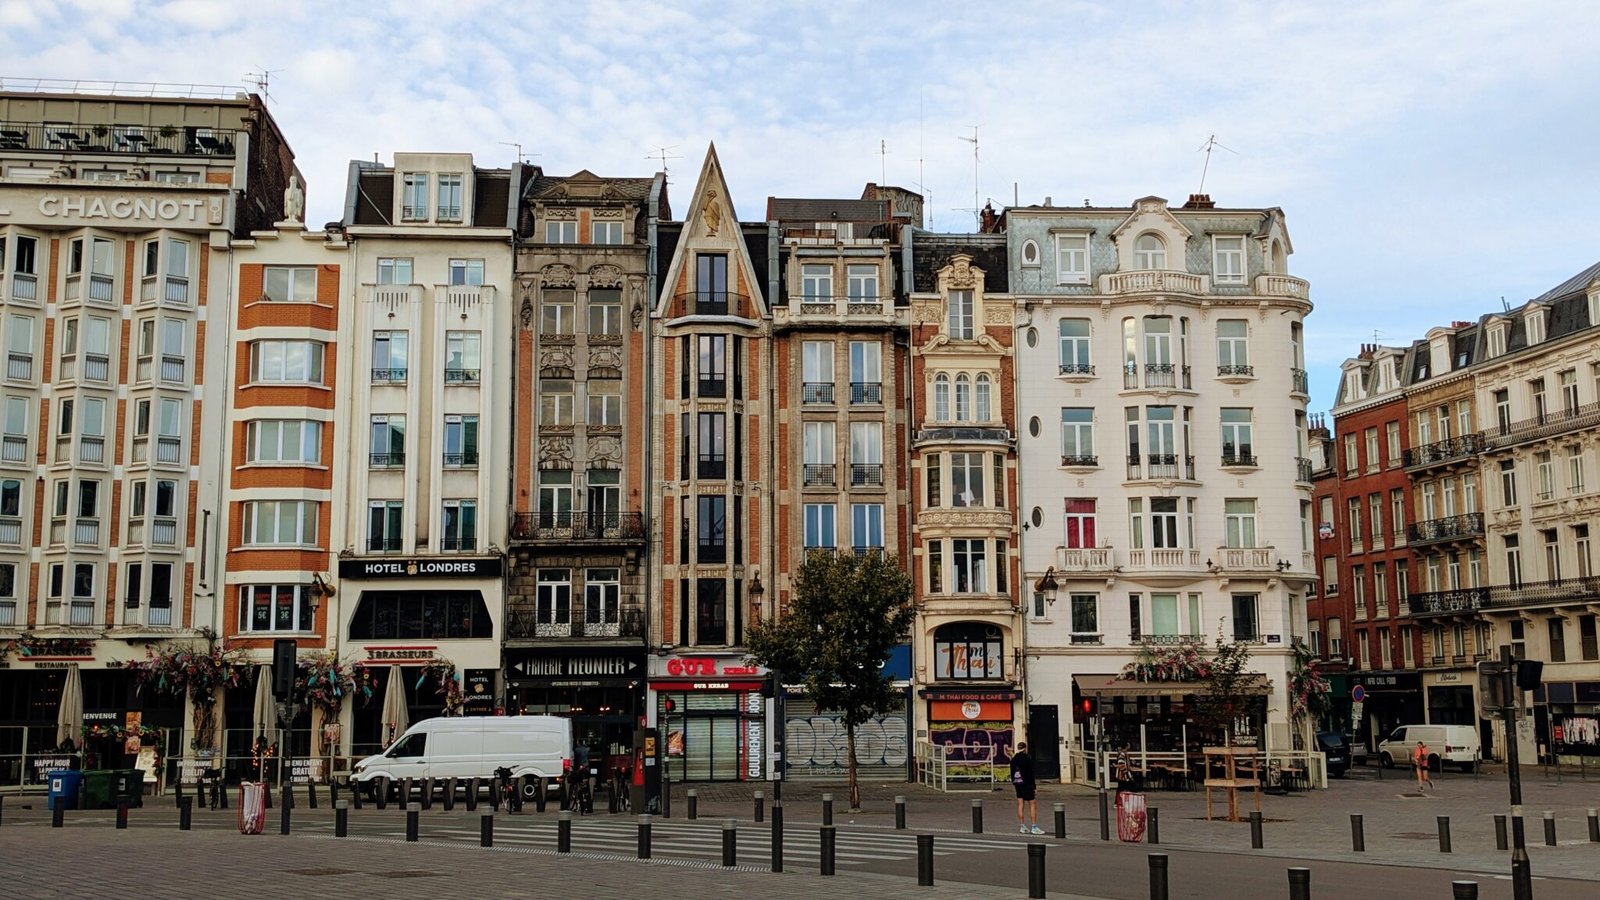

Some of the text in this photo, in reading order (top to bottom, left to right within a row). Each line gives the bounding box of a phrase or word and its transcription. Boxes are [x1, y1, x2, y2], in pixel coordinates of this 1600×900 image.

[38, 196, 203, 221] CHAGNOT
[365, 562, 476, 573] HOTEL LONDRES
[32, 647, 92, 657] BRASSEURS
[367, 651, 434, 660] 3 BRASSEURS
[526, 656, 625, 675] FRITERIE MEUNIER
[667, 658, 716, 675] GUR
[748, 720, 761, 778] GUUUREMENT
[34, 759, 70, 767] HAPPY HOUR
[292, 768, 318, 776] GRATUIT
